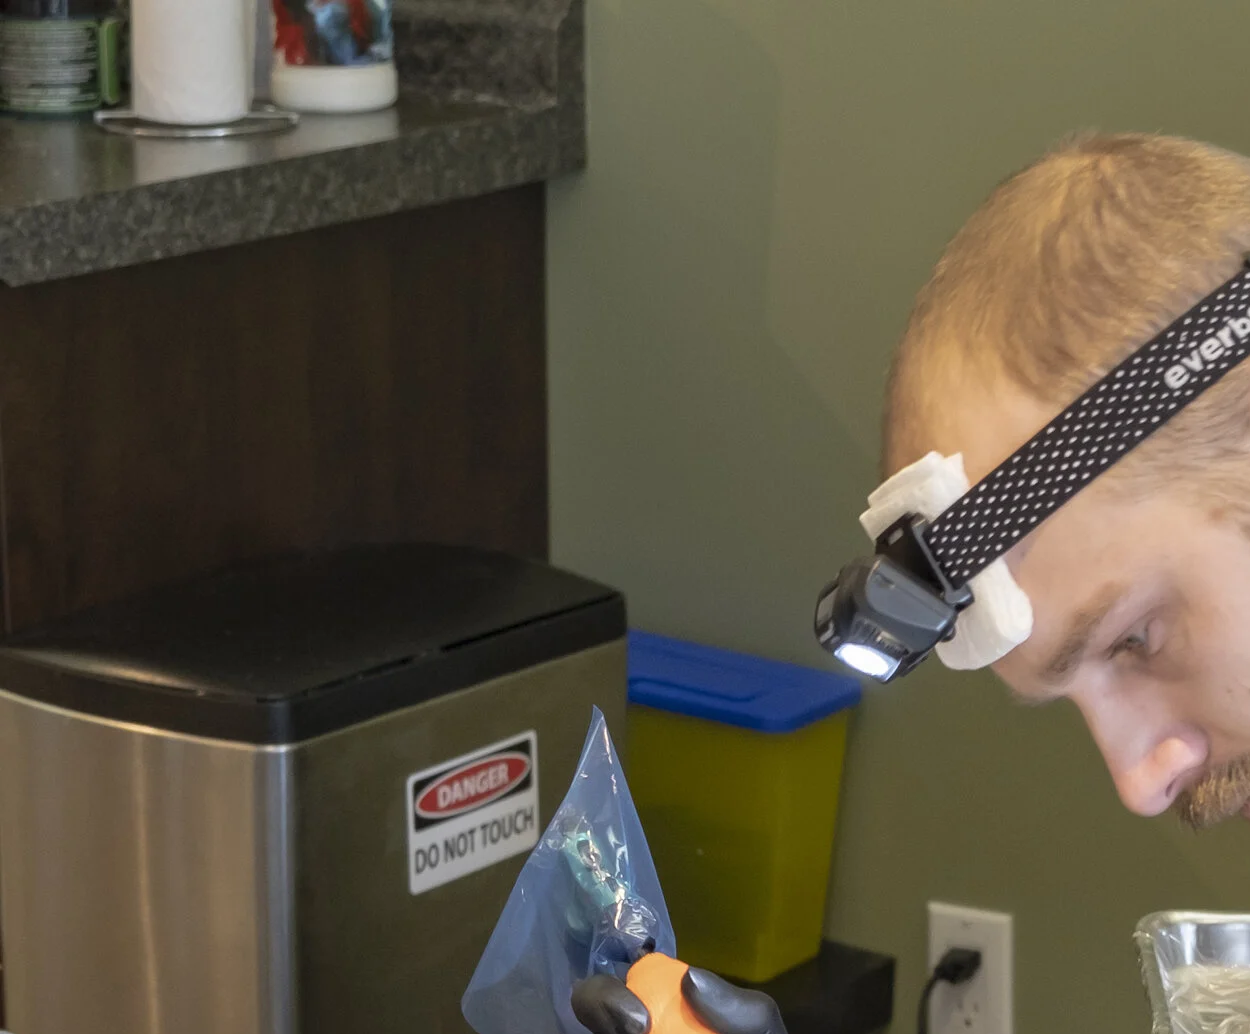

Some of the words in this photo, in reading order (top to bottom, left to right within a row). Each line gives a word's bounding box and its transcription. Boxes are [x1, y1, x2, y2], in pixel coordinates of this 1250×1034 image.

[436, 762, 510, 809] DANGER
[414, 843, 440, 874] DO
[444, 829, 476, 864] NOT
[481, 807, 534, 849] TOUCH
